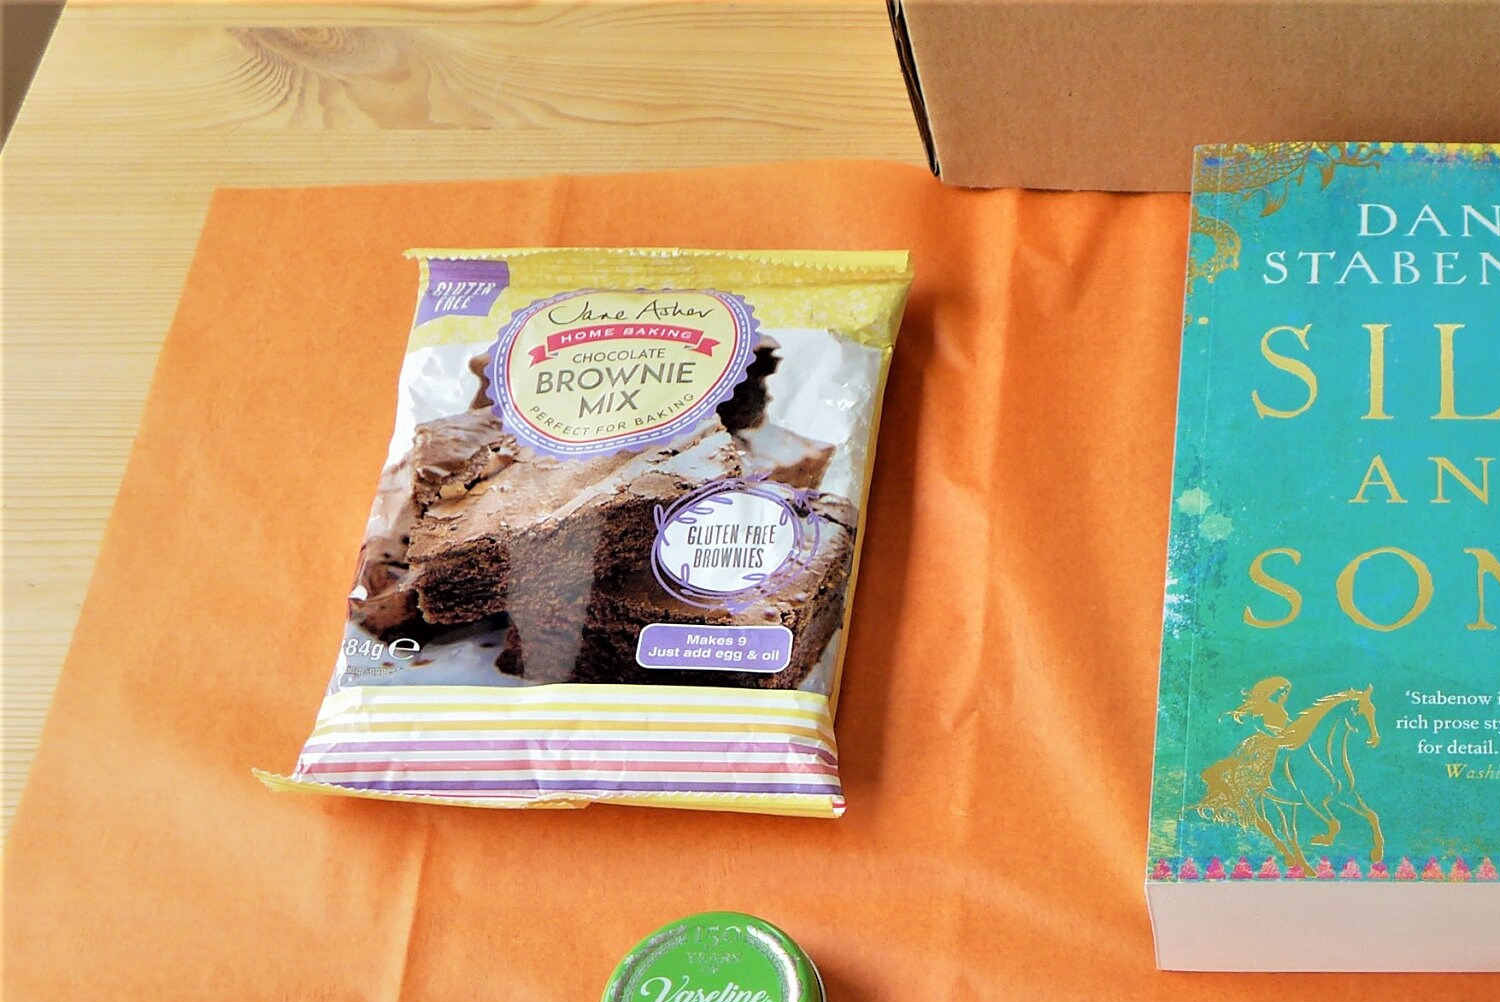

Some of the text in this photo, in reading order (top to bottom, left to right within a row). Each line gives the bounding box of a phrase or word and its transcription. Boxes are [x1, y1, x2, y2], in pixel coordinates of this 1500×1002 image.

[548, 299, 715, 326] Jane Asher
[560, 325, 693, 343] HOME BAKING
[572, 347, 666, 364] CHOCOLATE
[535, 361, 694, 395] BROWNIE
[529, 392, 695, 437] PERFECT FOR BAKING
[578, 389, 639, 419] MIX
[688, 524, 776, 546] GLUTEN FREE
[693, 547, 764, 569] BROWNIES
[686, 633, 747, 648] Makes 9
[648, 645, 780, 665] Just add egg & oil
[1395, 714, 1428, 731] rich
[1433, 717, 1479, 736] prose
[1417, 739, 1443, 756] for
[1447, 740, 1499, 756] detail.
